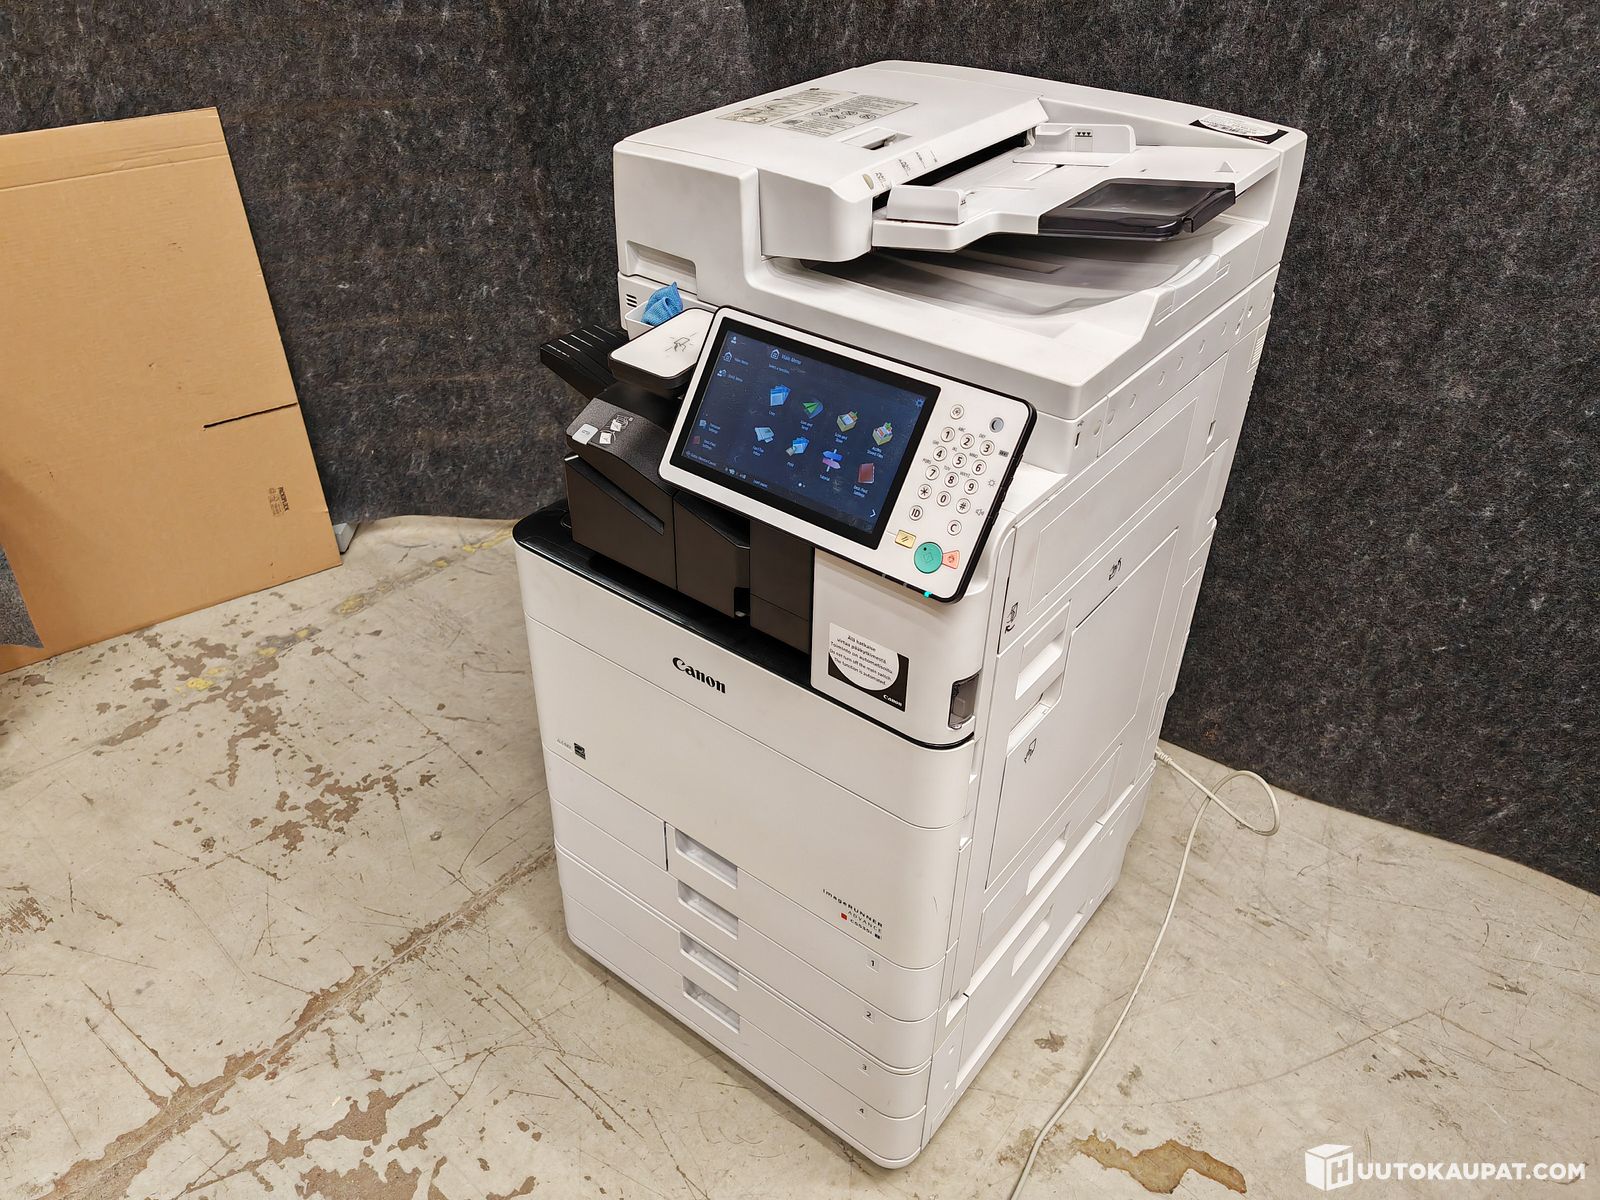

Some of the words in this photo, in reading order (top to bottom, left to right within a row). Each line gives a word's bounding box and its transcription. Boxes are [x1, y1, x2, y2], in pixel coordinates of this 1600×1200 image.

[963, 437, 970, 446] 2
[983, 444, 990, 453] 3
[936, 449, 943, 458] 4
[956, 456, 963, 465] 5
[975, 463, 982, 472] 6
[929, 468, 936, 477] 7
[947, 475, 955, 484] 8
[968, 482, 975, 491] 9
[940, 494, 947, 503] 0
[911, 508, 921, 518] ID
[950, 523, 958, 533] C
[672, 657, 726, 694] Canon
[883, 694, 903, 707] Canon
